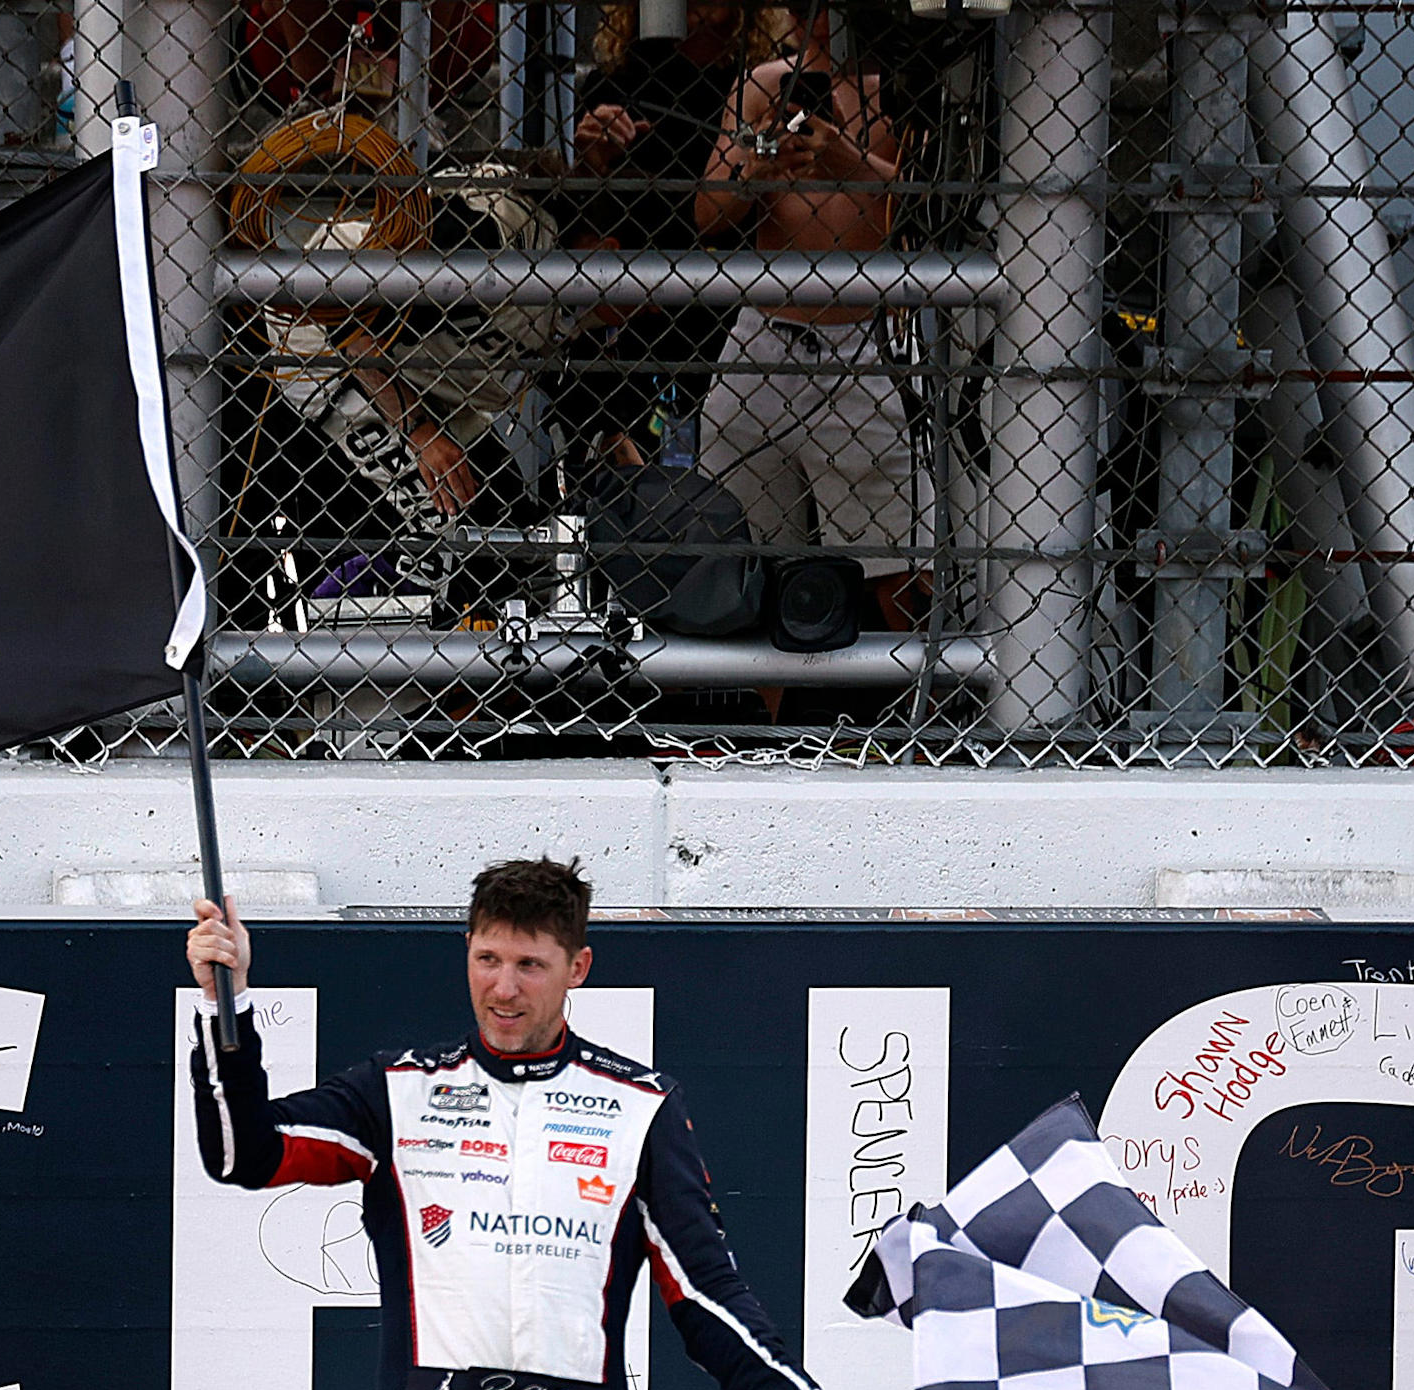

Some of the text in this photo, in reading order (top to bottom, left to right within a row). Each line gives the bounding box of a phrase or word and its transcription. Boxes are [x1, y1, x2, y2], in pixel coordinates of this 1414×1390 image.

[1203, 1031, 1285, 1122] Hodge
[544, 1091, 622, 1113] TOYOTA
[542, 1122, 614, 1140] PROGRESSIVE
[460, 1139, 508, 1157] BOB'S
[460, 1169, 510, 1186] yahoo!
[470, 1211, 602, 1246] NATIONAL
[494, 1242, 582, 1261] DEBT RELIEF
